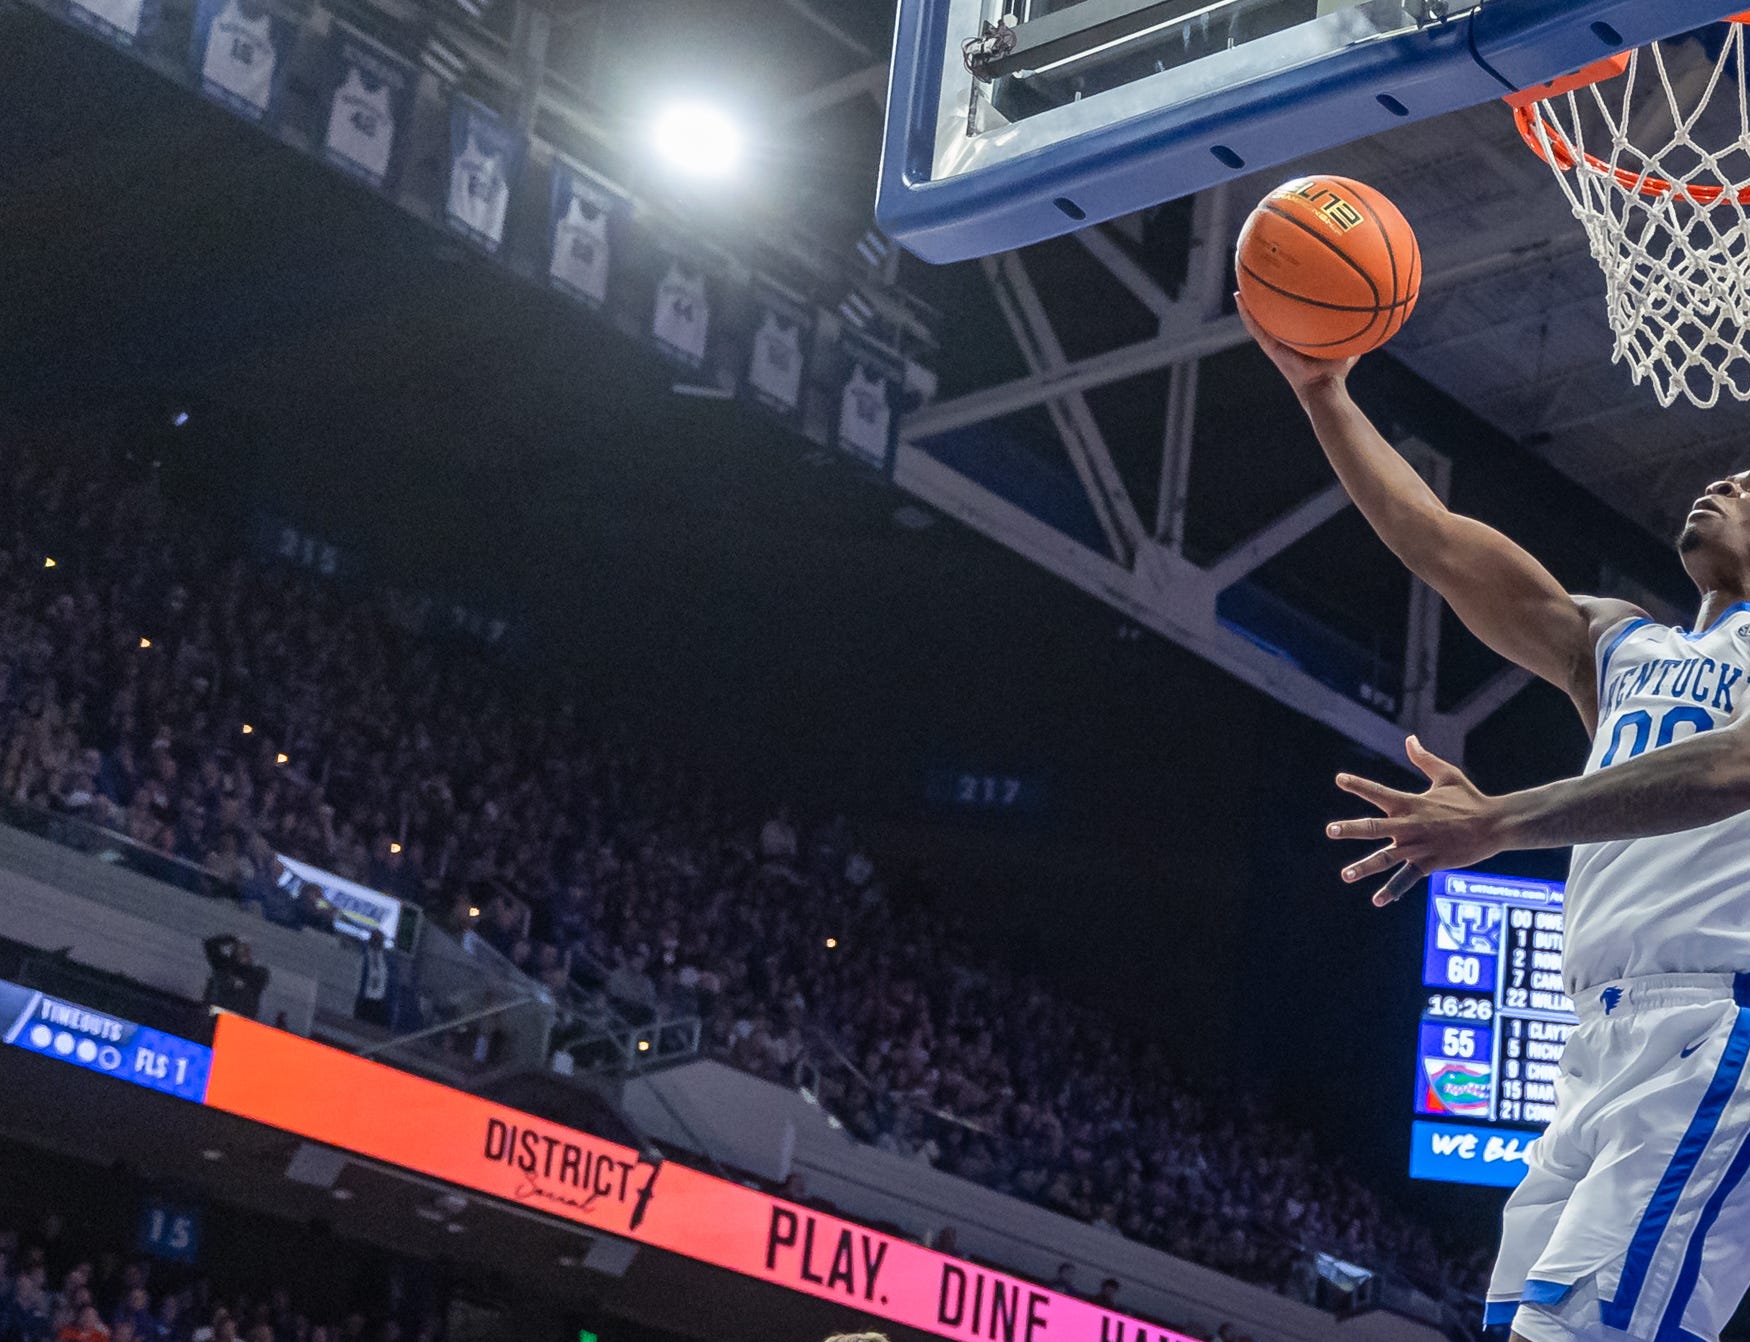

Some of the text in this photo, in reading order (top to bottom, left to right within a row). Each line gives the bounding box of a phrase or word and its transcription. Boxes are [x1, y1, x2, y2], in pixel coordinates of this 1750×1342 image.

[1510, 908, 1533, 928] 00
[1516, 929, 1527, 947] 1
[1512, 948, 1527, 968] 2
[1447, 956, 1480, 985] 60
[1512, 968, 1525, 987] 7
[1428, 994, 1493, 1020] 16:26
[1506, 987, 1528, 1008] 22
[1510, 1019, 1522, 1038] 1
[1442, 1028, 1475, 1058] 55
[1507, 1037, 1520, 1058] 5
[175, 1057, 189, 1086] 1
[1502, 1080, 1523, 1100] 15
[1500, 1100, 1521, 1121] 21
[1432, 1132, 1478, 1159] WE
[484, 1118, 634, 1203] DISTRICT
[151, 1209, 190, 1248] 15
[765, 1205, 888, 1305] PLAY.
